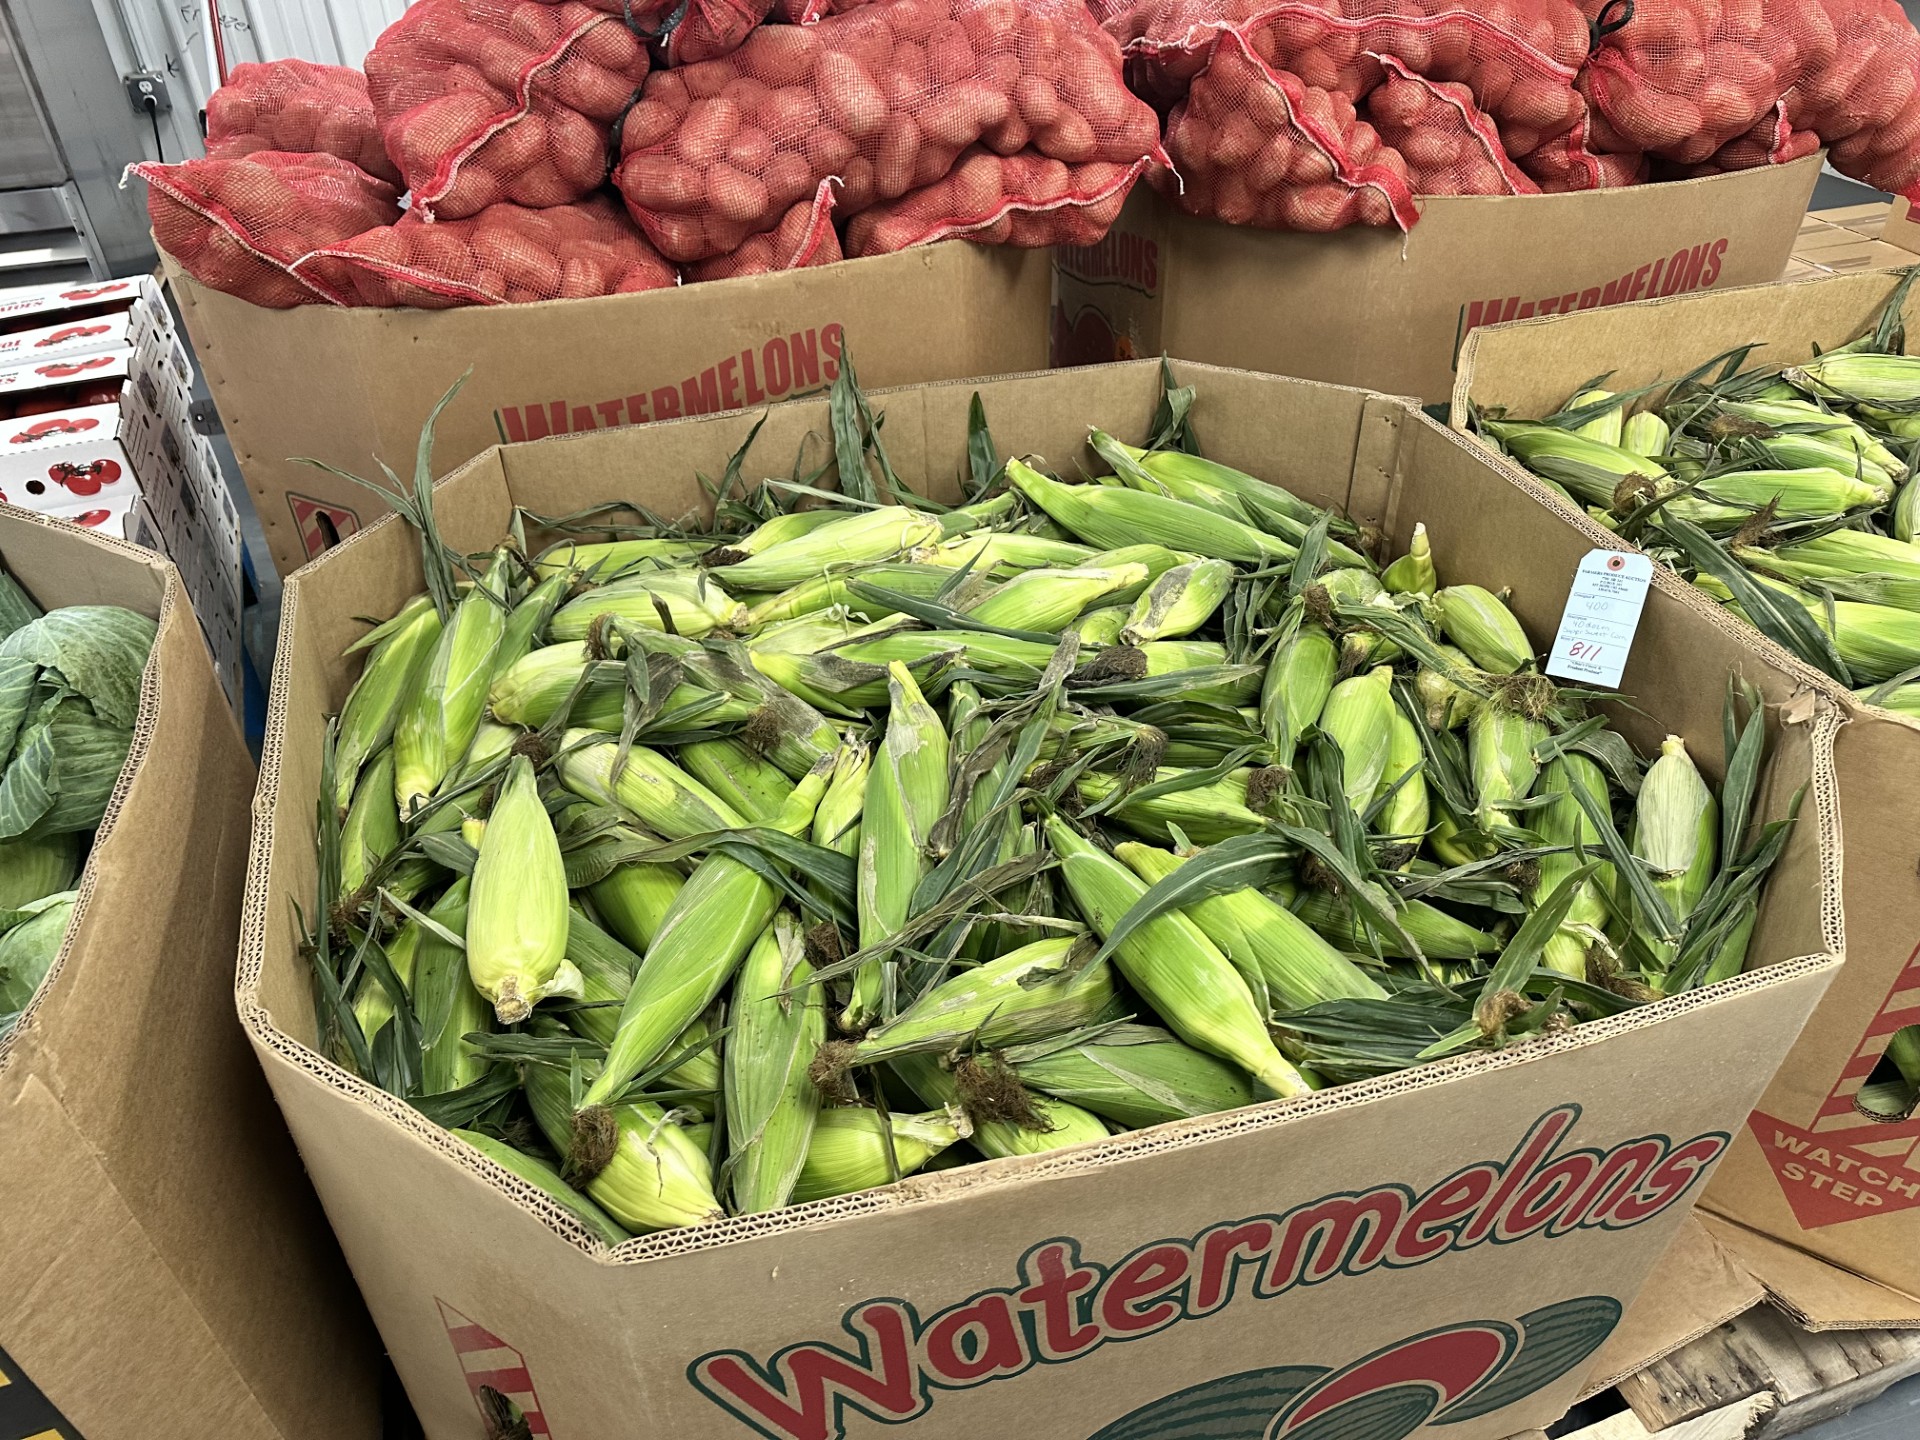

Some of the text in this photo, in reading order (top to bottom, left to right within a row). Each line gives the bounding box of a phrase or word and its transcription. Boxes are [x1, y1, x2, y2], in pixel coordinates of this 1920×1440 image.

[1055, 230, 1158, 290] ATERMELONS
[1585, 601, 1609, 611] 400
[1569, 642, 1602, 661] 811
[1774, 1129, 1920, 1200] WATCH
[1781, 1162, 1883, 1207] STEP
[690, 1103, 1731, 1440] Watermelons
